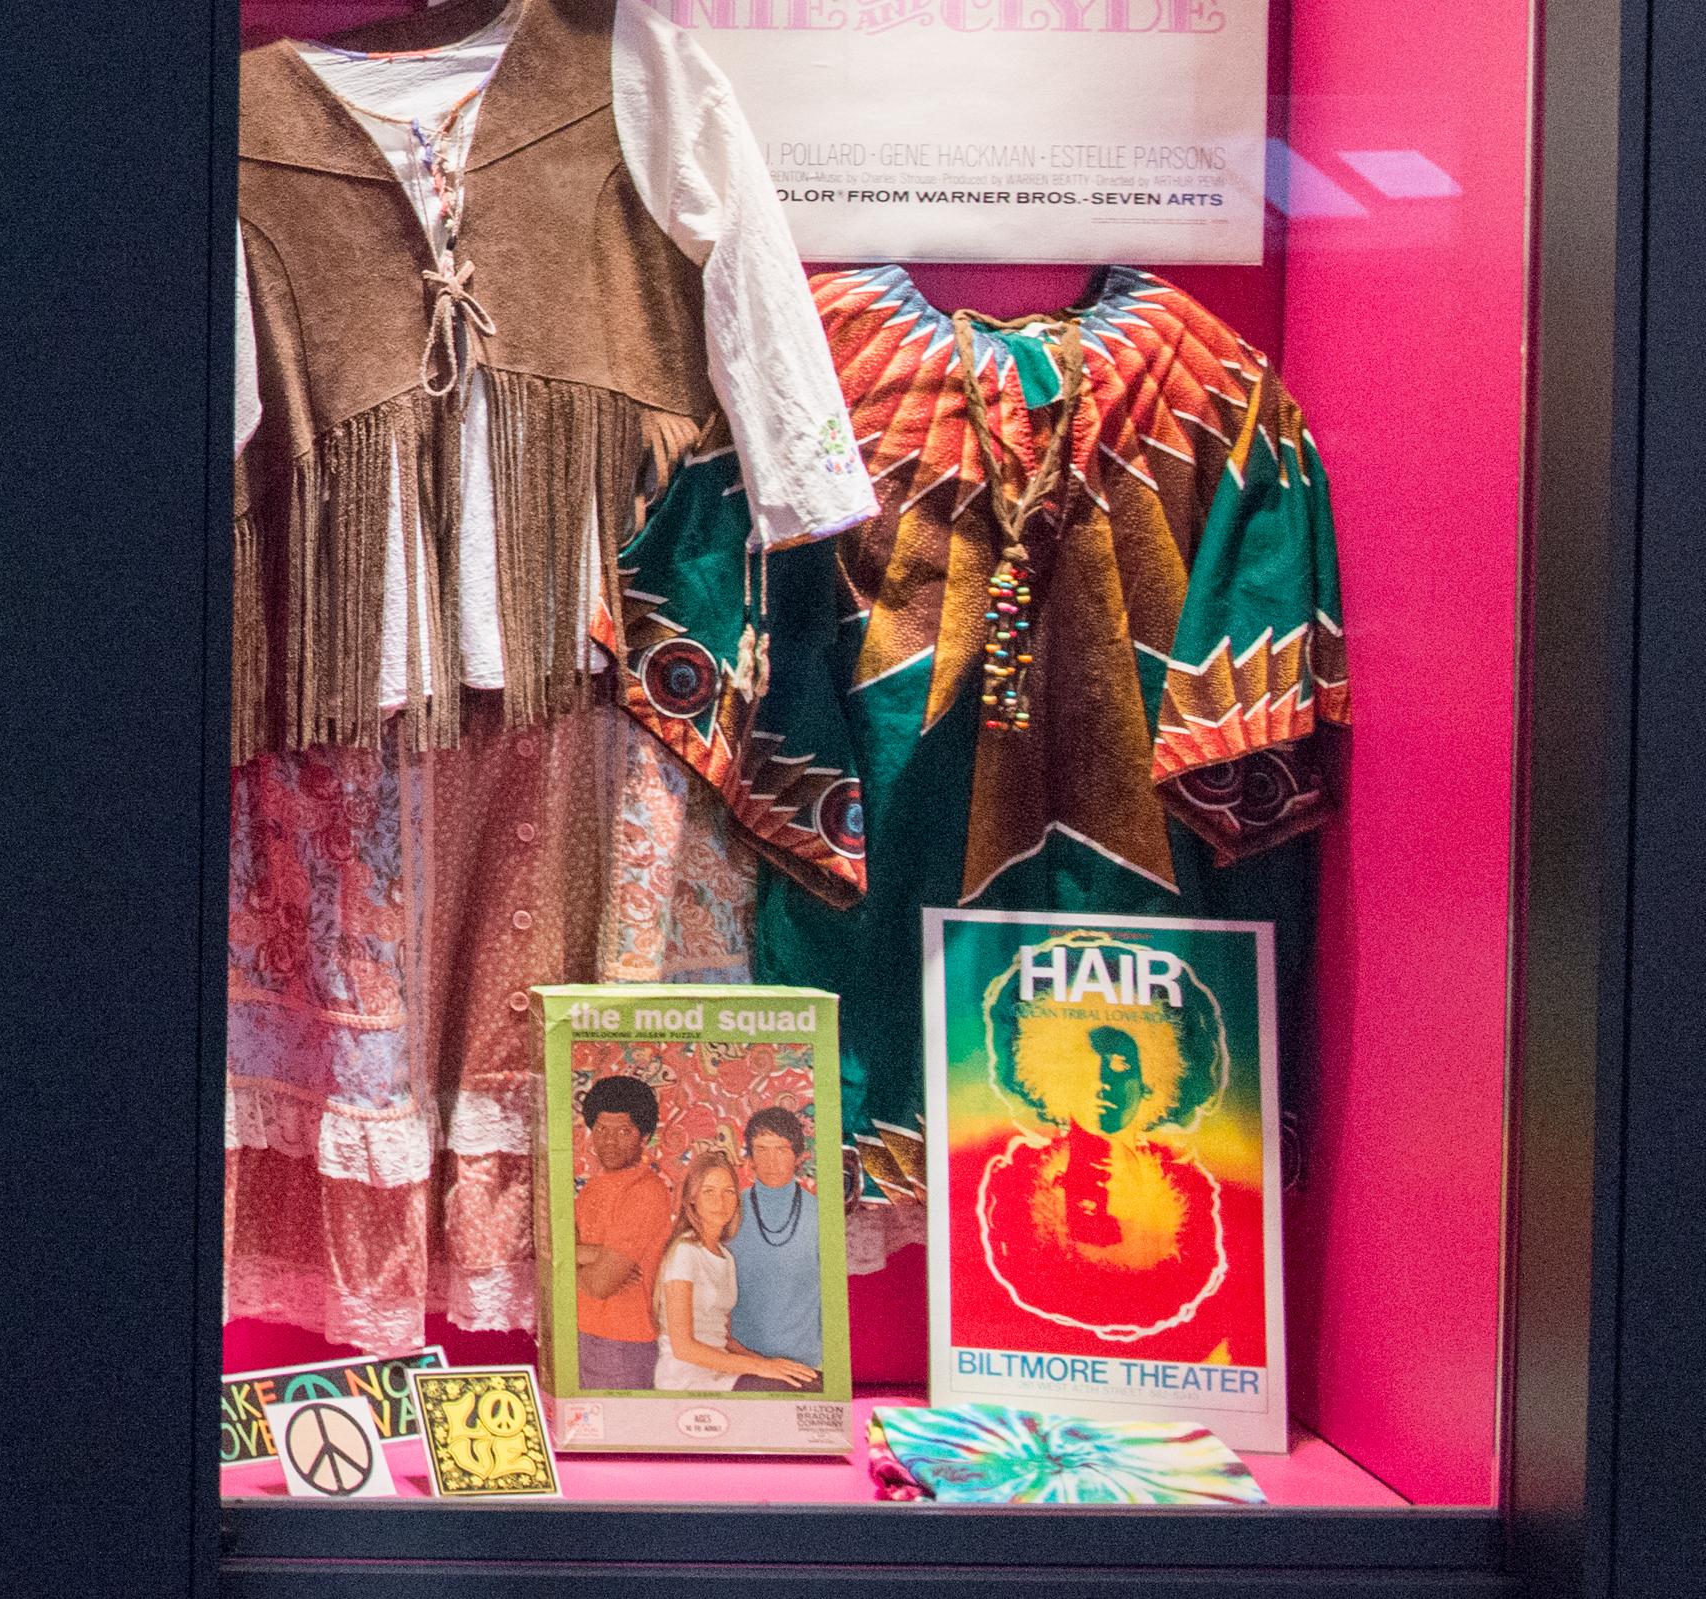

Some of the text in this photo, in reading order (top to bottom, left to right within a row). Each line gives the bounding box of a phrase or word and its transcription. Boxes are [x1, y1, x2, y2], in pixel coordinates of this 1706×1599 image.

[572, 1002, 815, 1035] the mod squad
[958, 1350, 1259, 1393] BILTMORE THEATER
